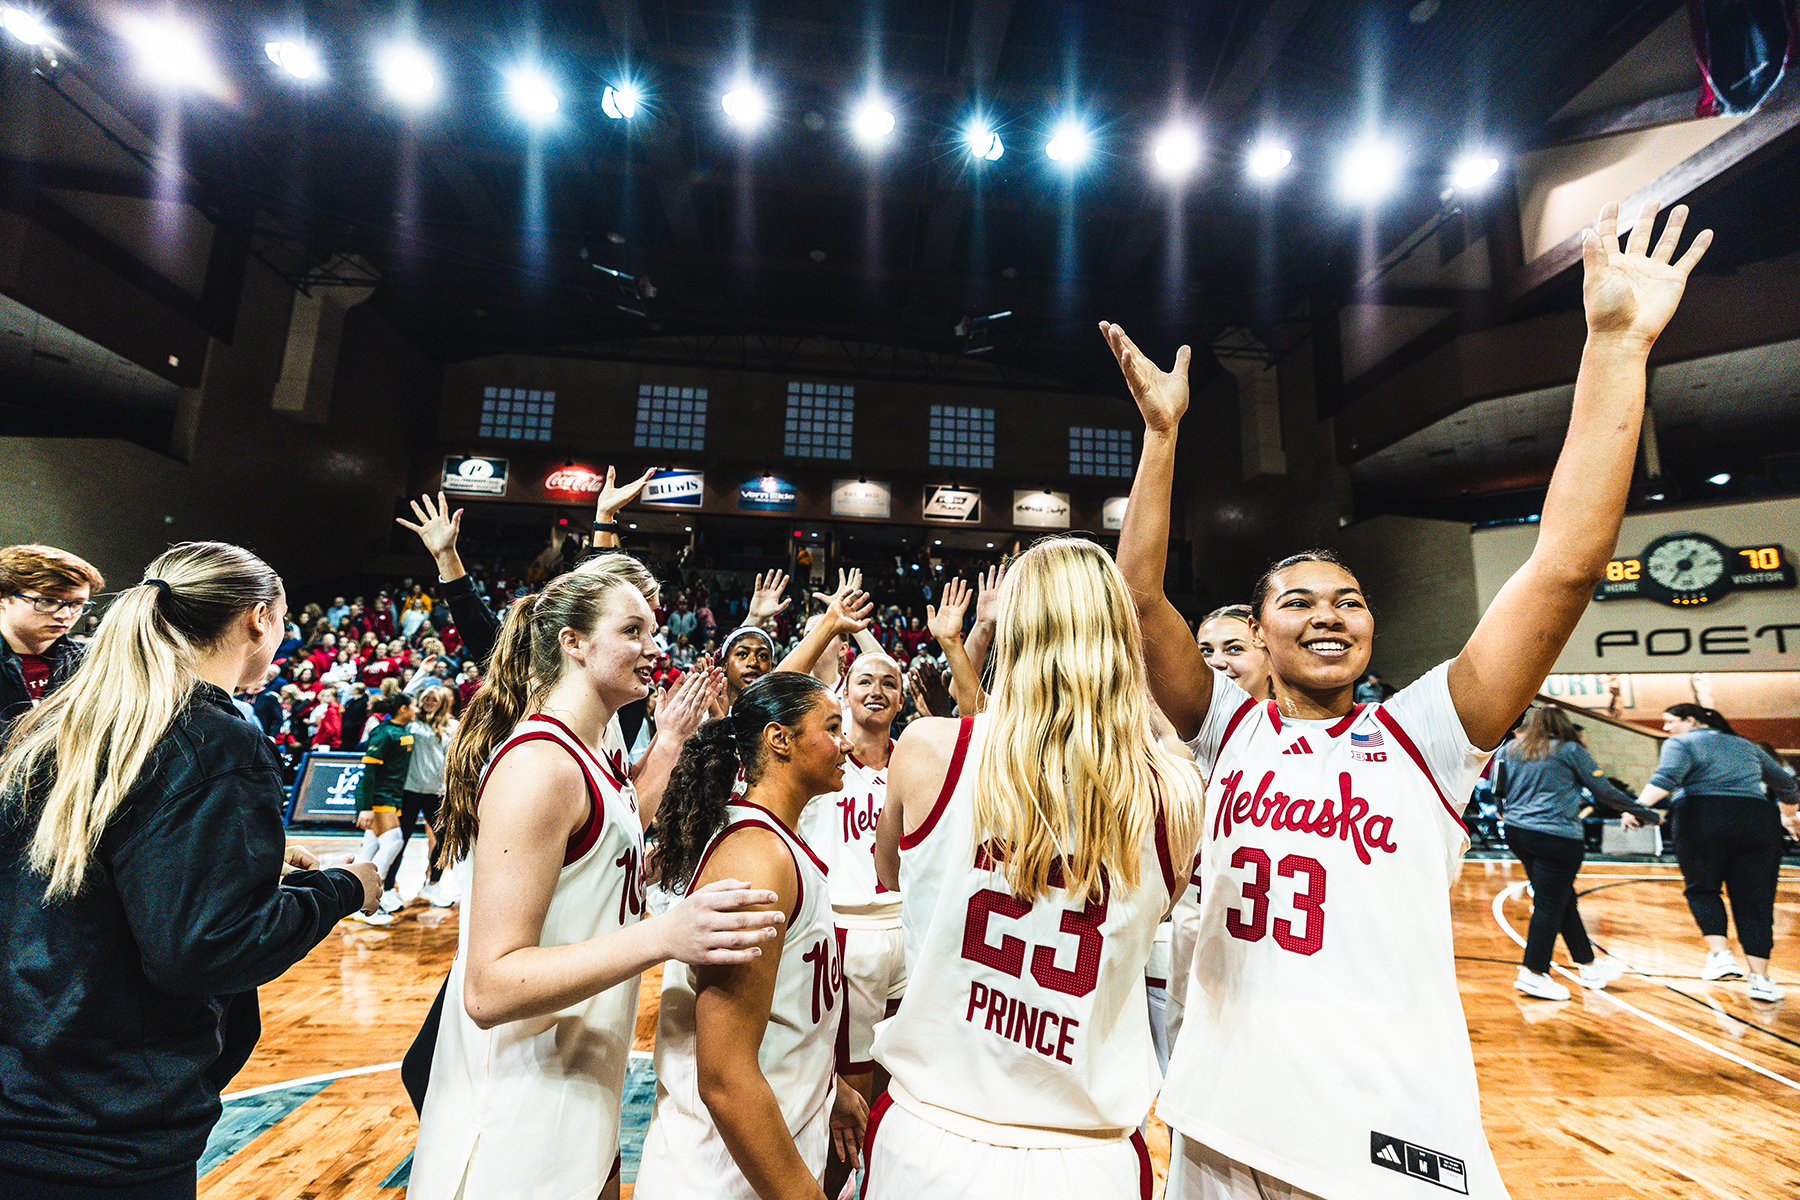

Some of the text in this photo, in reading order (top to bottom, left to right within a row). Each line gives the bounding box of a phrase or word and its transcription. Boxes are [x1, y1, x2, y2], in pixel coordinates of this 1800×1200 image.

[660, 480, 699, 494] LEWIS
[1606, 559, 1641, 581] 82
[1731, 571, 1785, 584] VISITOR
[1739, 548, 1780, 570] 70
[1595, 624, 1800, 658] POET
[836, 792, 882, 843] Neb
[1213, 769, 1397, 865] Nebraska
[961, 836, 1111, 998] 23
[1225, 846, 1326, 956] 33
[802, 938, 841, 1024] Ne
[965, 980, 1079, 1065] PRINCE
